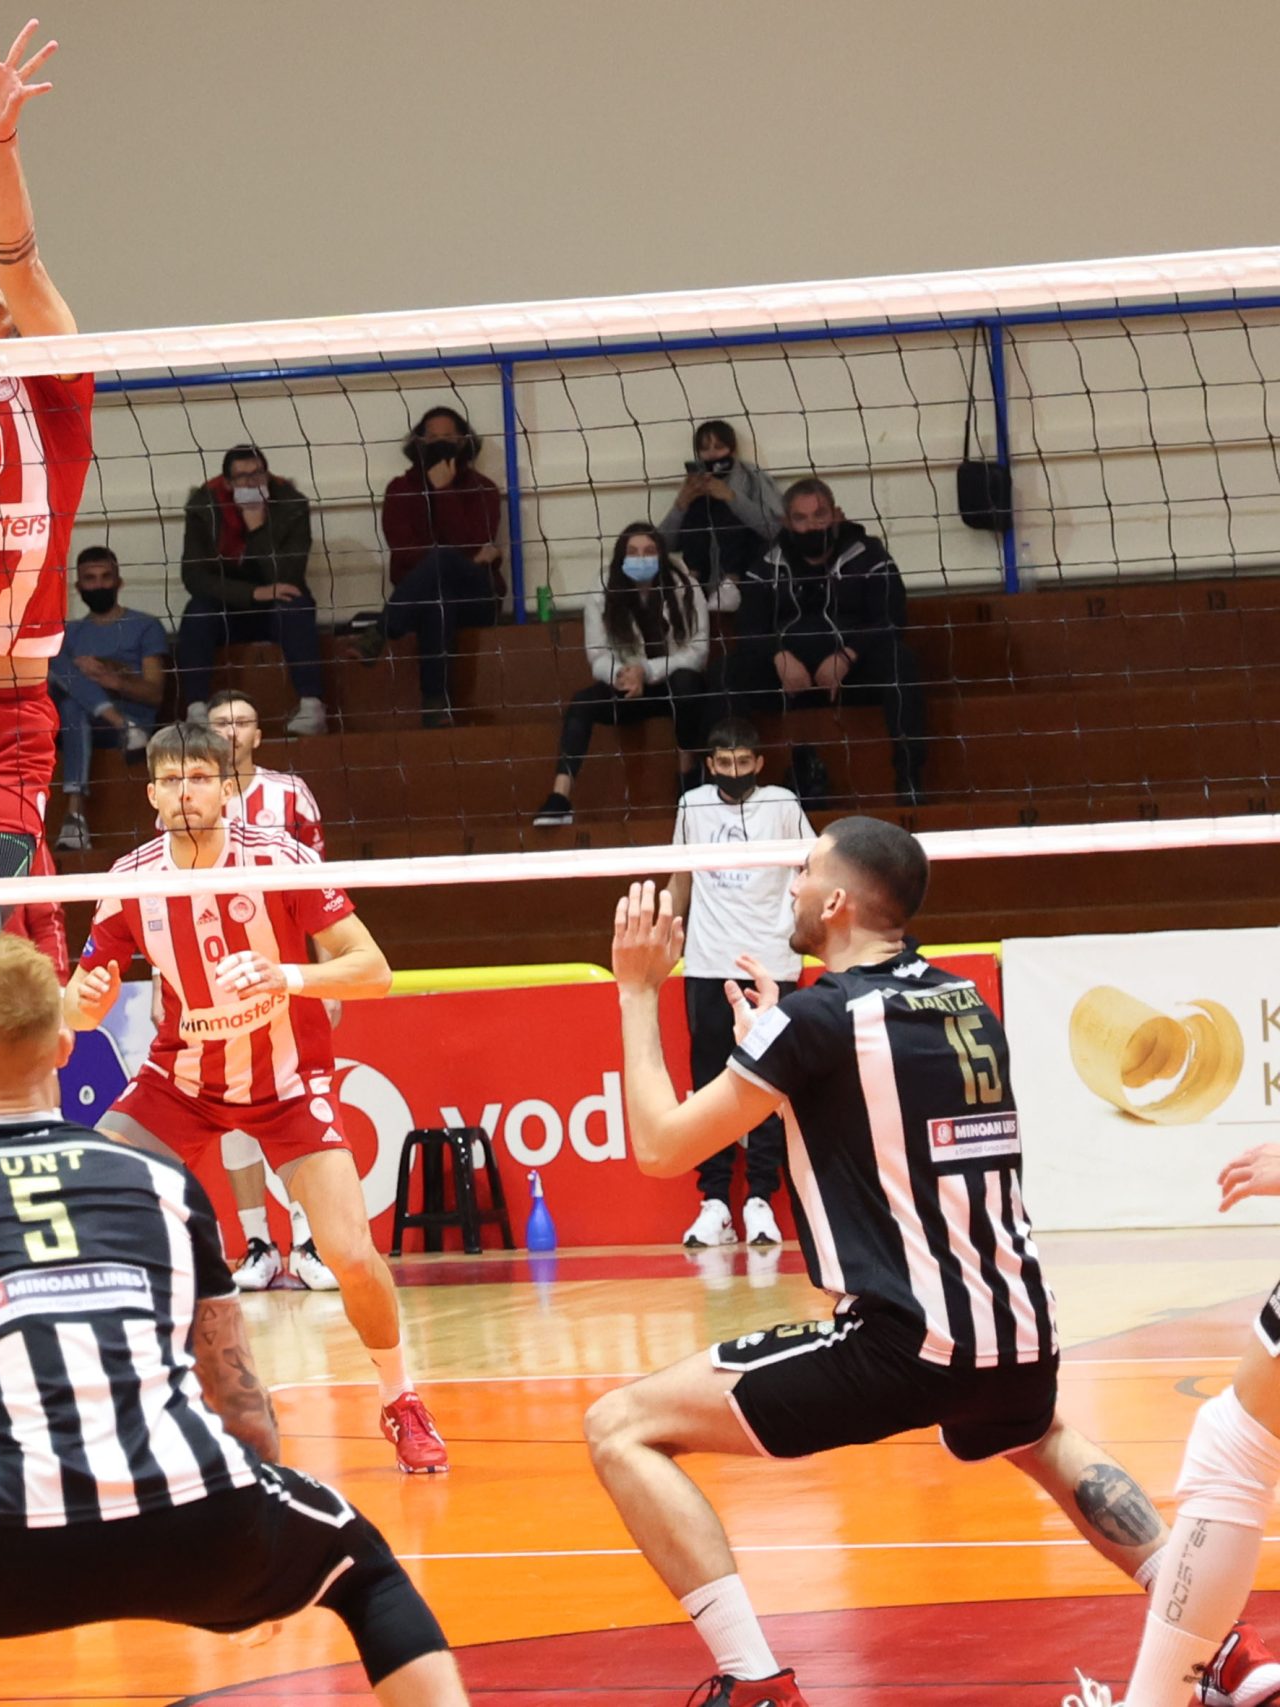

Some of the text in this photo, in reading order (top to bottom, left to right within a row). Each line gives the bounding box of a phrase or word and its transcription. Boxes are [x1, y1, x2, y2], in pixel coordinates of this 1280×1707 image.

[944, 1014, 1003, 1105] 15
[953, 1121, 1002, 1139] MINOAN
[9, 1176, 80, 1263] 5
[7, 1272, 144, 1297] MINOAN LINES
